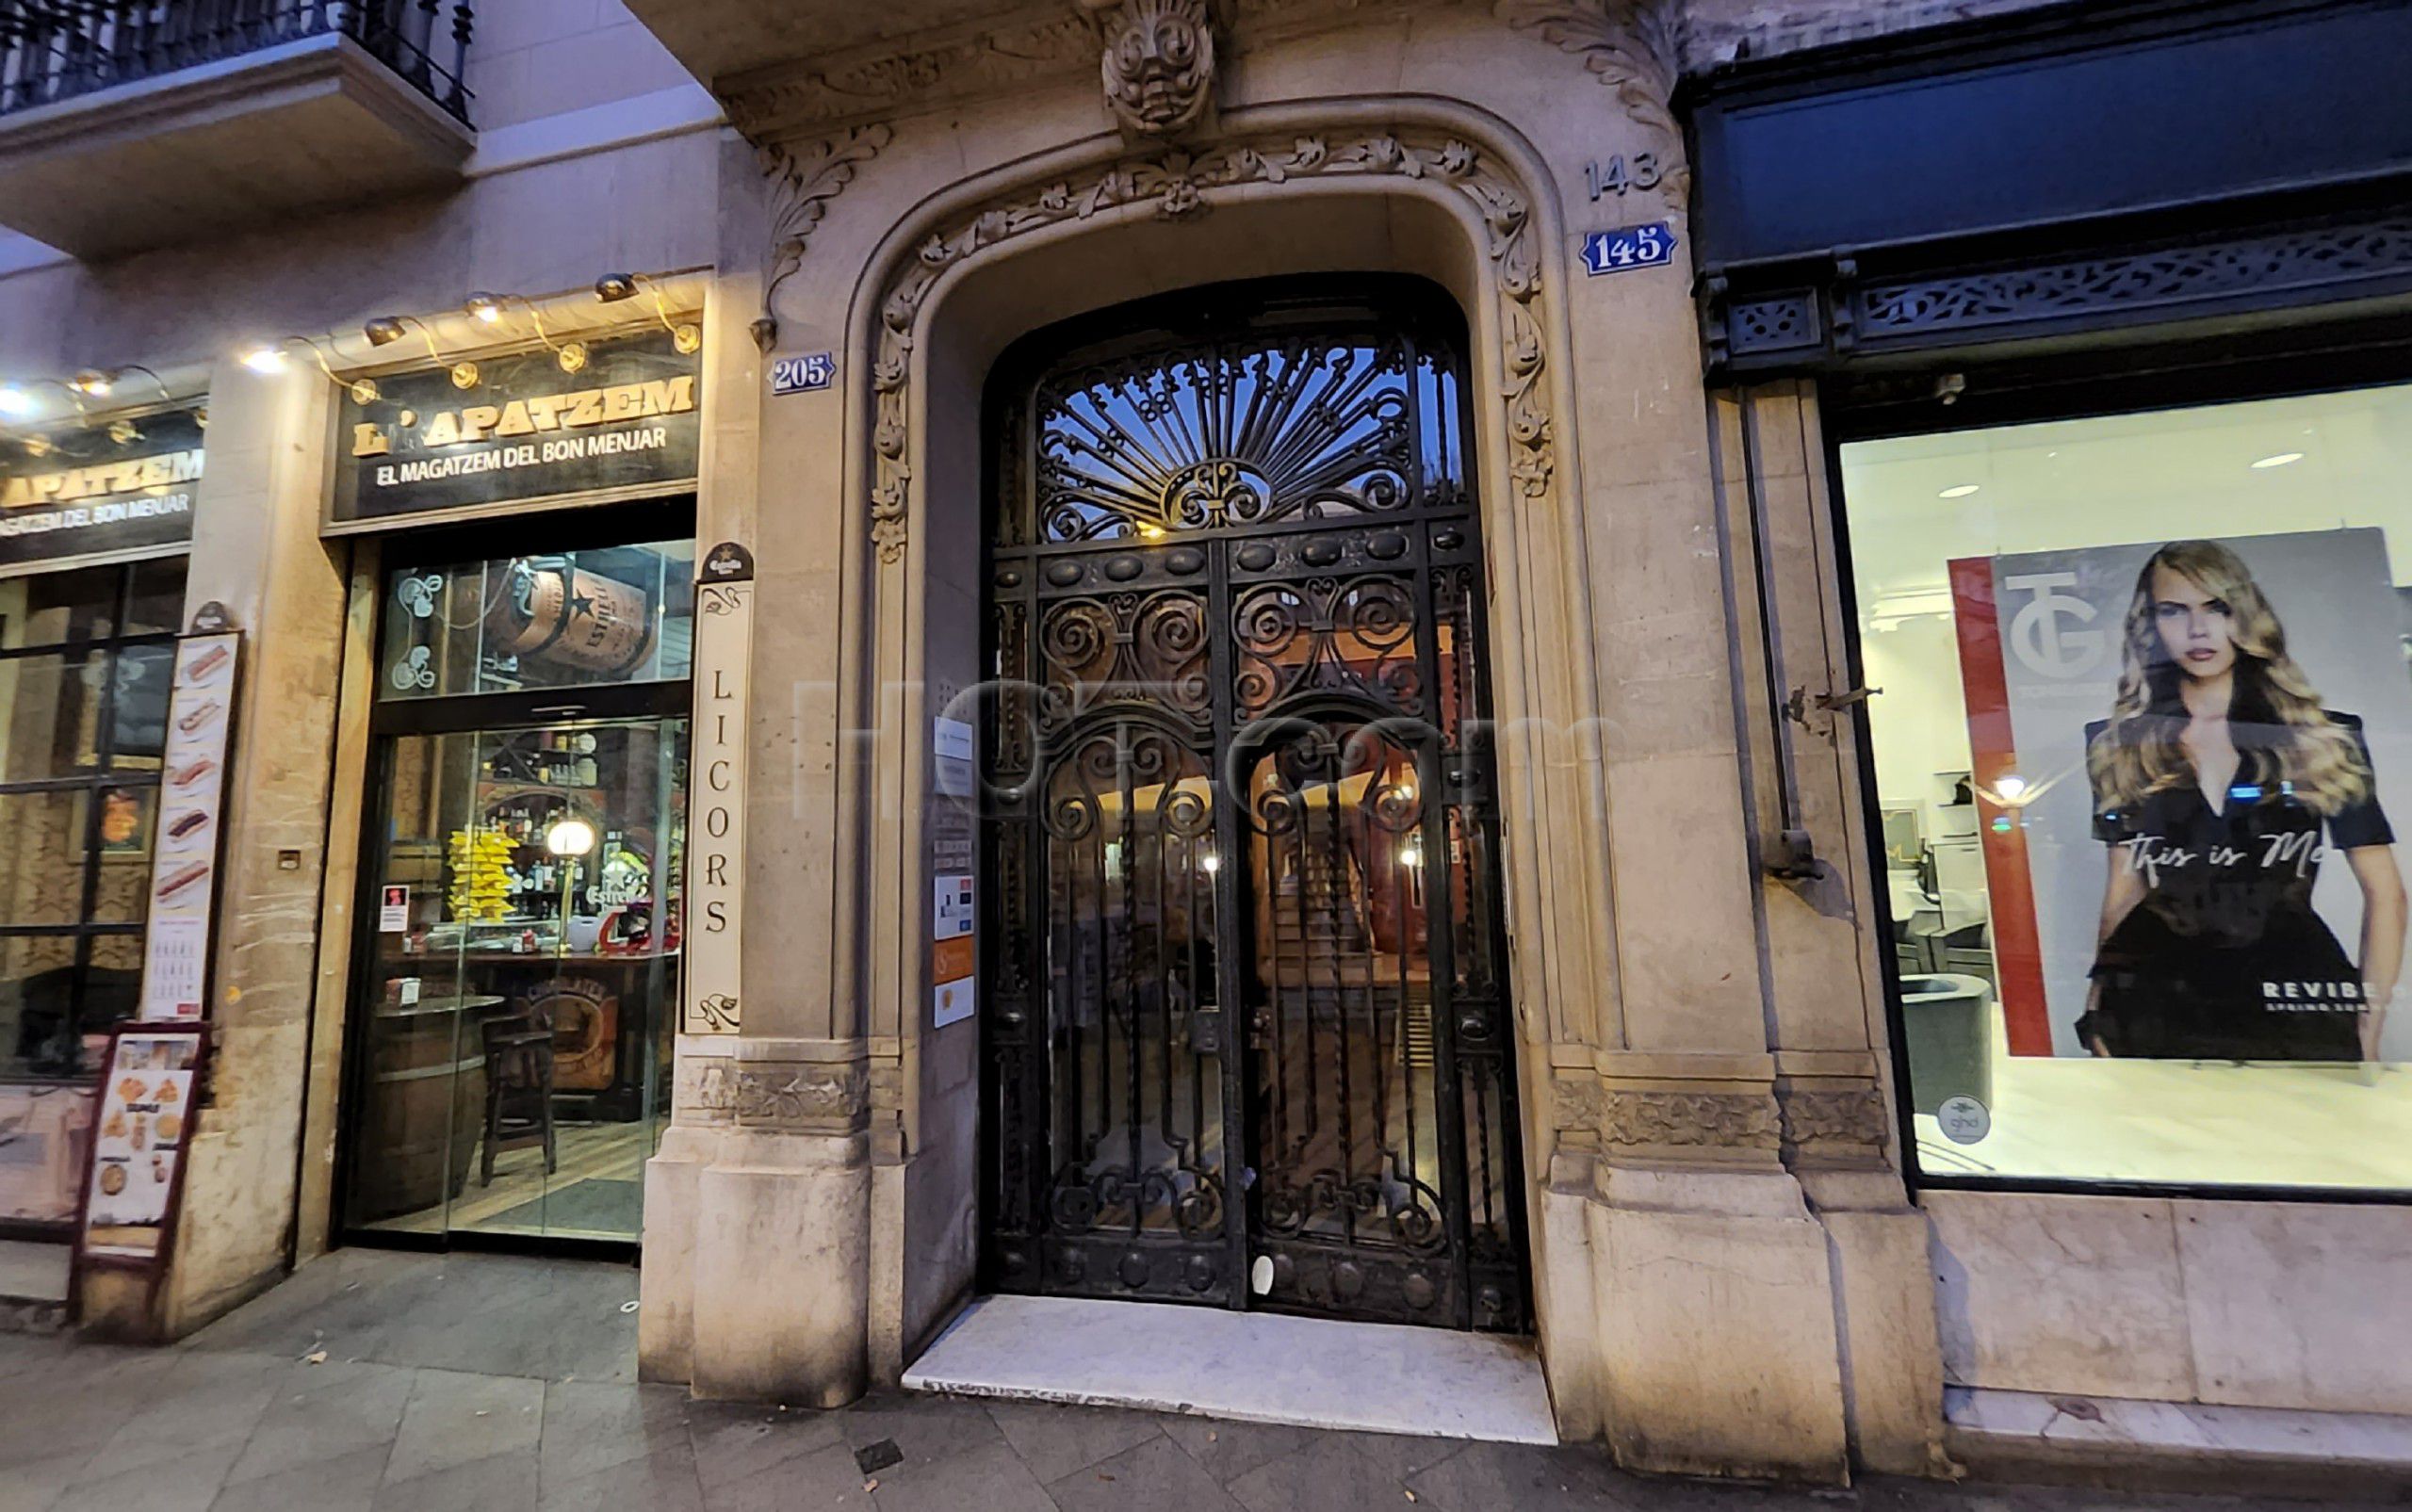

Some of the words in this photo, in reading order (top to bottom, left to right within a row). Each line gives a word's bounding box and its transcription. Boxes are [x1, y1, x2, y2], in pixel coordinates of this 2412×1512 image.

[1585, 152, 1661, 202] 143
[1595, 227, 1662, 268] 145
[774, 357, 826, 389] 205
[352, 375, 696, 457] L'APATZEM
[377, 464, 399, 486] EL
[400, 455, 501, 482] MAGATZEM
[503, 447, 540, 468] DEL
[542, 438, 584, 463] BON
[588, 427, 667, 458] MENJAR
[705, 669, 733, 934] LICORS
[2117, 832, 2200, 889] This
[2209, 844, 2248, 867] is
[2262, 982, 2381, 999] REVIBE
